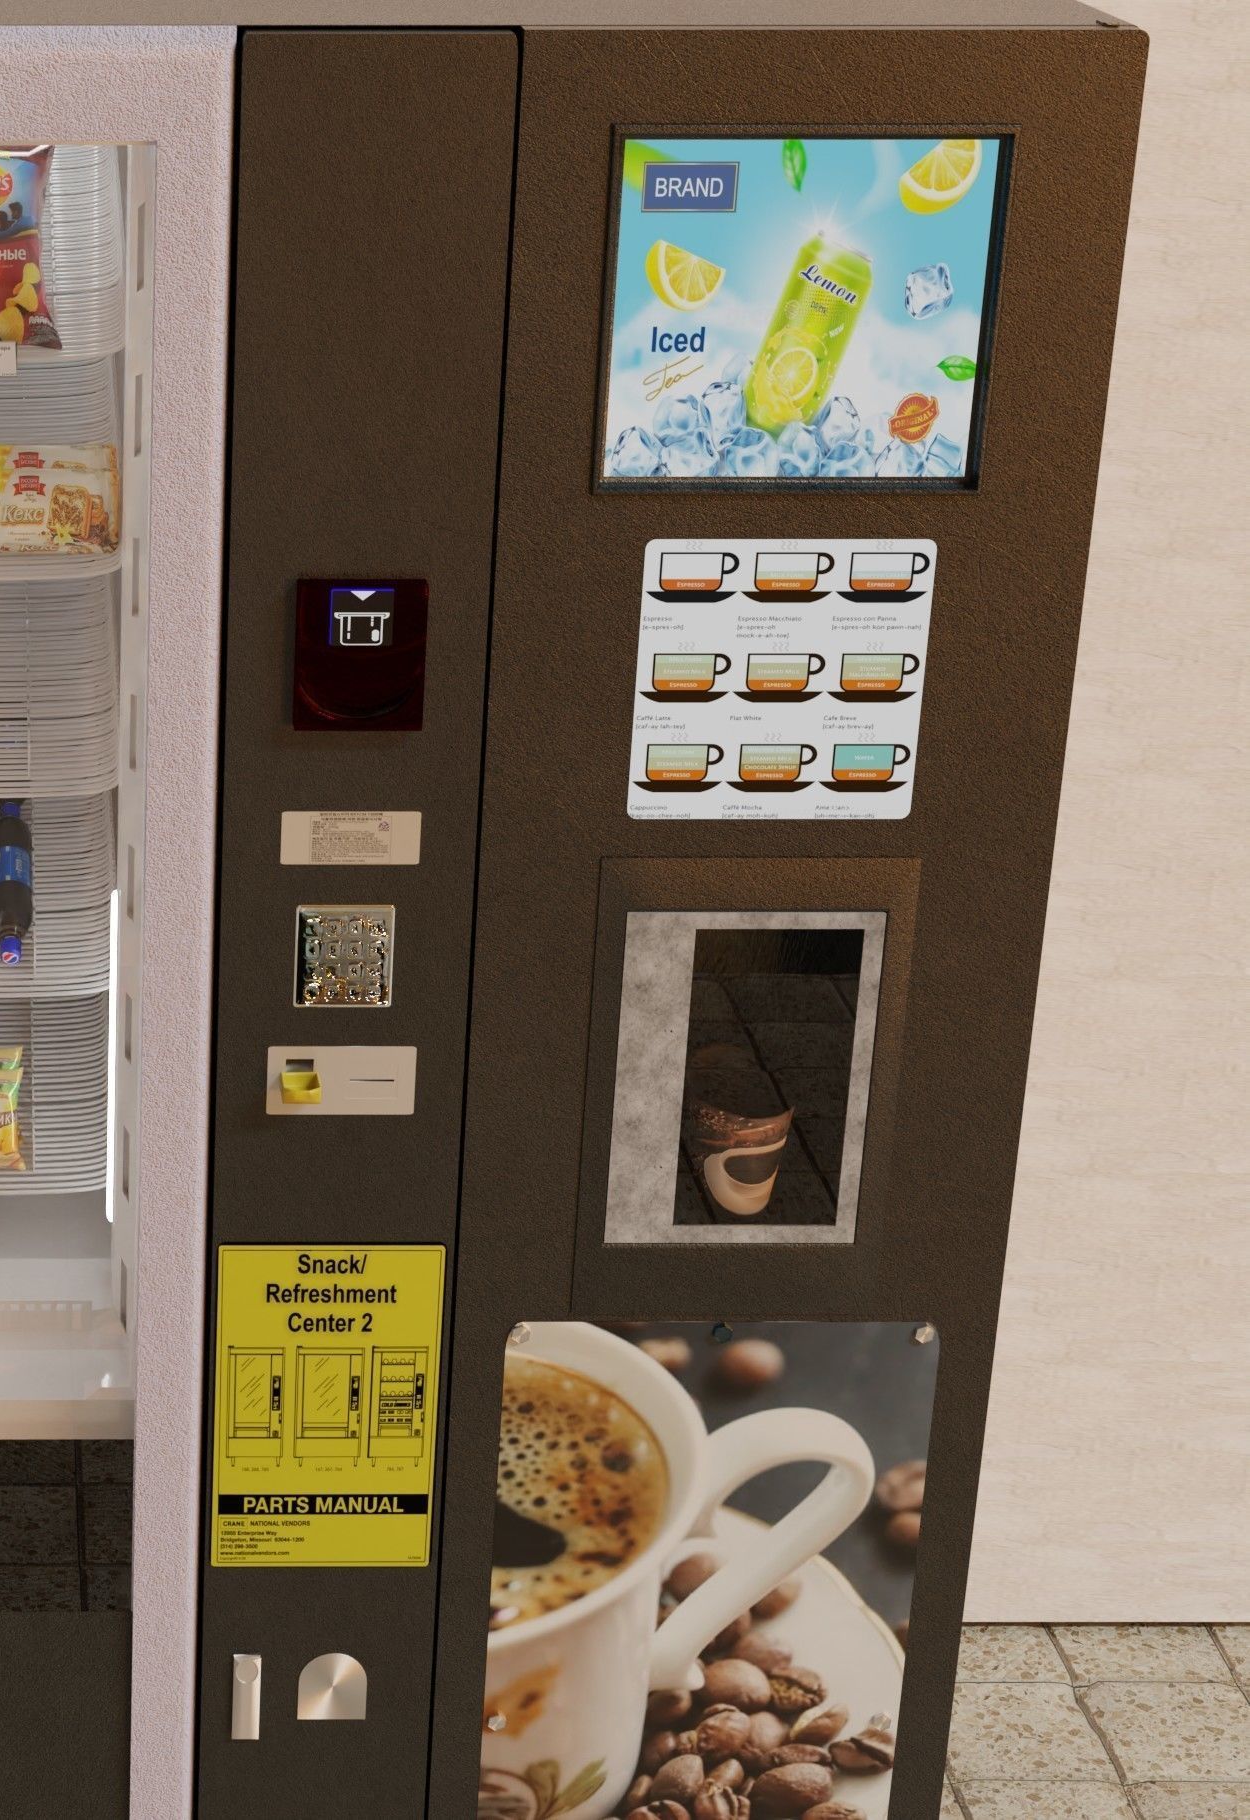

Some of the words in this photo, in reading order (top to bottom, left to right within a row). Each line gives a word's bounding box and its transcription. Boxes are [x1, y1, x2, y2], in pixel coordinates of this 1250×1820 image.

[654, 177, 724, 198] BRAND
[799, 264, 857, 304] Lemon
[651, 326, 705, 354] Iced
[298, 1254, 368, 1274] Snack/
[266, 1284, 397, 1304] Refreshment
[288, 1313, 355, 1333] Center
[361, 1313, 373, 1332] 2
[243, 1497, 310, 1514] PARTS
[315, 1496, 405, 1514] MANUAL
